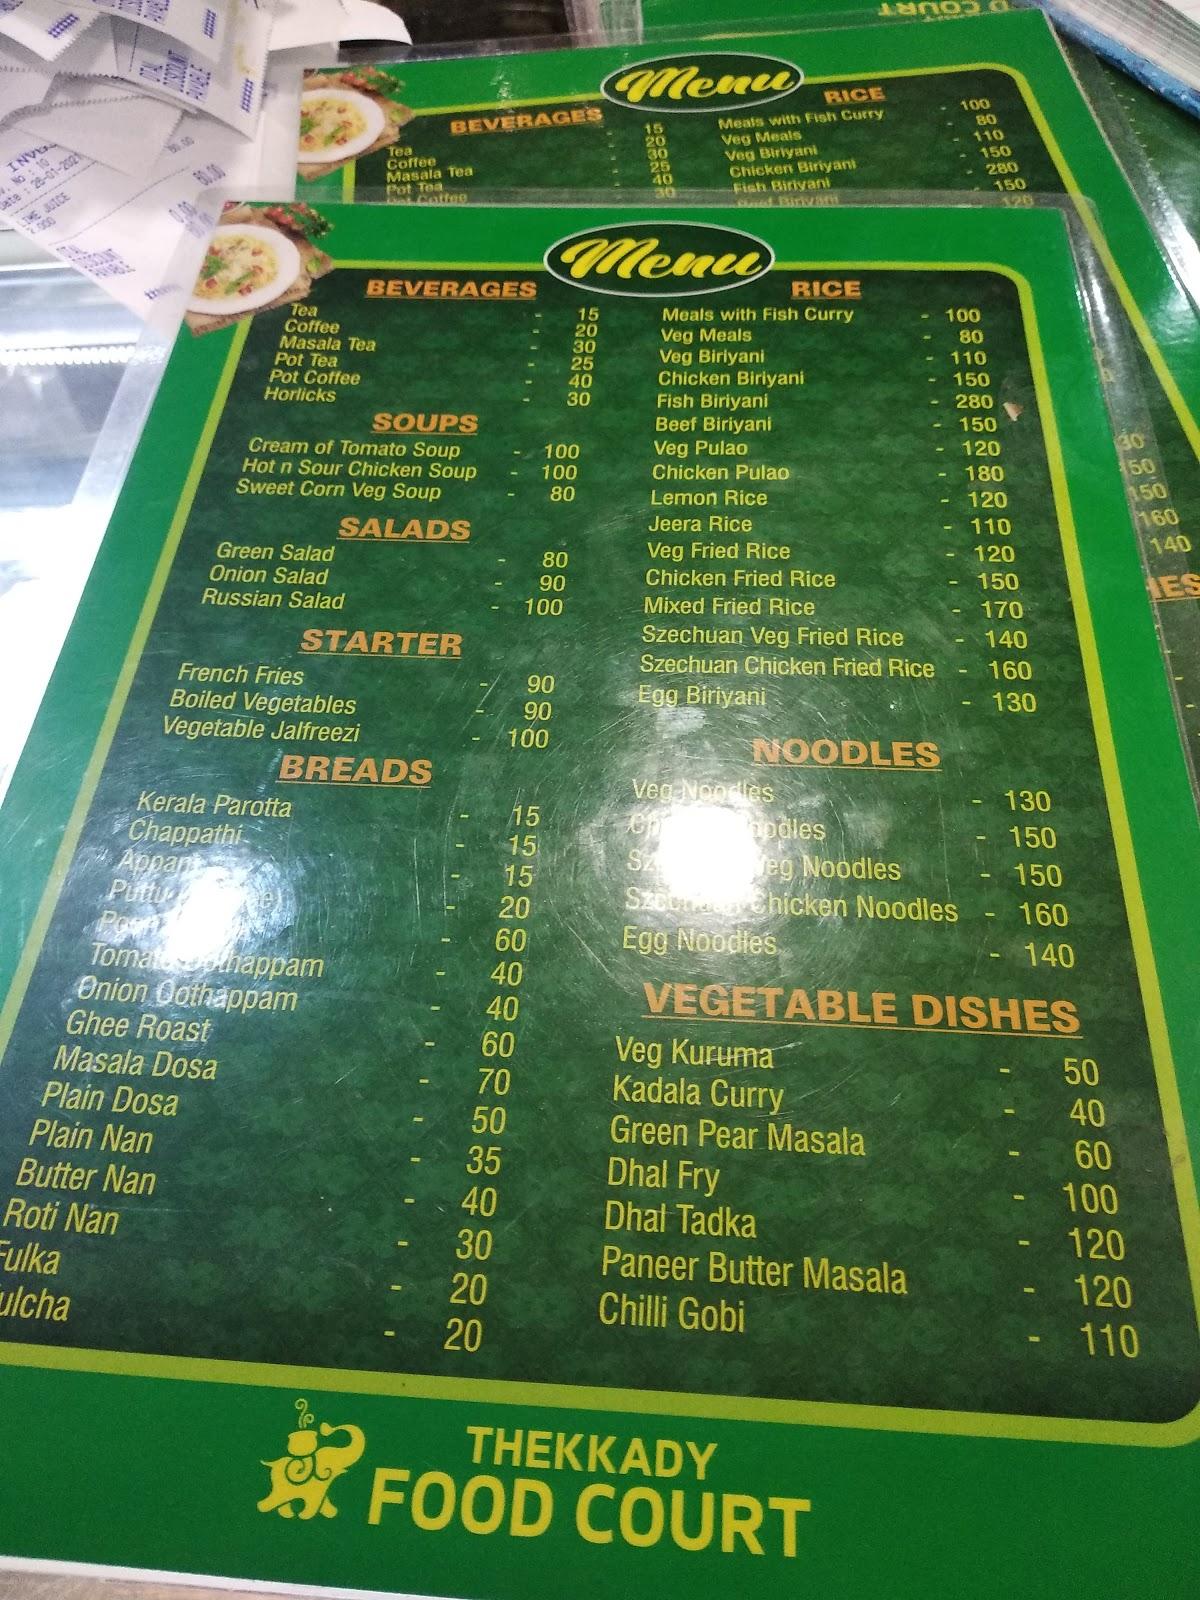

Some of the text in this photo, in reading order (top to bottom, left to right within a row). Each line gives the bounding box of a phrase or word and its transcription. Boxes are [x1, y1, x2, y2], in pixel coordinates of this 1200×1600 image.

[614, 66, 796, 104] Menu
[823, 87, 885, 104] RICE
[451, 107, 603, 135] BEVERAGES
[719, 100, 991, 130] Meals with Fish Curry 100
[389, 123, 663, 156] Tea 15
[721, 114, 997, 146] Veg Meals 80
[387, 136, 665, 170] Coffee 20
[725, 129, 1004, 162] Veg Biriyani 110
[387, 149, 668, 183] Masala Tea 30
[650, 162, 670, 173] 25
[730, 145, 1011, 178] Chicken Biriyani 150
[652, 174, 673, 185] 40
[771, 178, 830, 193] Biriyani
[986, 162, 1018, 174] 280
[994, 178, 1026, 191] 150
[560, 238, 766, 281] Menu
[365, 280, 537, 298] BEVERAGES
[791, 280, 862, 300] RICE
[291, 304, 599, 321] Tea 15
[662, 307, 981, 324] Meals with Fish Curry 100
[284, 319, 597, 337] Coffee 20
[279, 336, 596, 353] Masala Tea 30
[274, 353, 594, 370] Pot Tea 25
[269, 370, 592, 388] Pot Coffee 40
[658, 371, 990, 388] Chicken Biriyani 150
[264, 387, 590, 406] Horlicks 30
[657, 394, 993, 411] Fish Biriyani 280
[370, 413, 479, 432] SOUPS
[248, 438, 580, 458] Cream of Tomato Soup 100
[242, 458, 577, 480] Hot n Sour Chicken Soup 100
[236, 479, 575, 501] Sweet Corn Veg Soup 80
[651, 489, 1007, 508] Lemon Rice 120
[336, 517, 471, 540] SALADS
[1139, 508, 1179, 526] 160
[216, 542, 568, 567] Green Salad 80
[1150, 535, 1192, 553] 140
[209, 565, 565, 591] Onion Salad 90
[645, 569, 1019, 590] Chicken Fried Rice 150
[298, 629, 463, 656] STARTER
[641, 625, 1028, 649] Szechuan Veg Fried Rice 140
[178, 663, 554, 693] French Fries 90
[170, 686, 552, 720] Boiled Vegetables 90
[163, 713, 549, 748] Vegetable Jalfreezi 100
[752, 738, 942, 768] NOODLES
[275, 755, 433, 784] BREADS
[137, 791, 540, 826] Kerala Parotta 15
[508, 835, 537, 856] 15
[622, 926, 1074, 969] Egg Noodles 140
[77, 975, 148, 1003] Onion
[486, 997, 519, 1021] 40
[641, 982, 1083, 1035] VEGETABLE DISHES
[53, 1044, 511, 1095] Masala Dosa 70
[612, 1075, 1106, 1127] Kadala Curry 40
[610, 1115, 1111, 1170] Green Pear Masala 60
[15, 1158, 497, 1217] Butter Nan 40
[604, 1201, 1125, 1261] Dhal Tadka 120
[449, 1272, 487, 1306] 20
[601, 1245, 1132, 1309] Paneer Butter Masala 120
[0, 1287, 482, 1352] ulcha 20
[466, 1425, 718, 1480] THEKKADY
[368, 1467, 811, 1558] FOOD COURT
